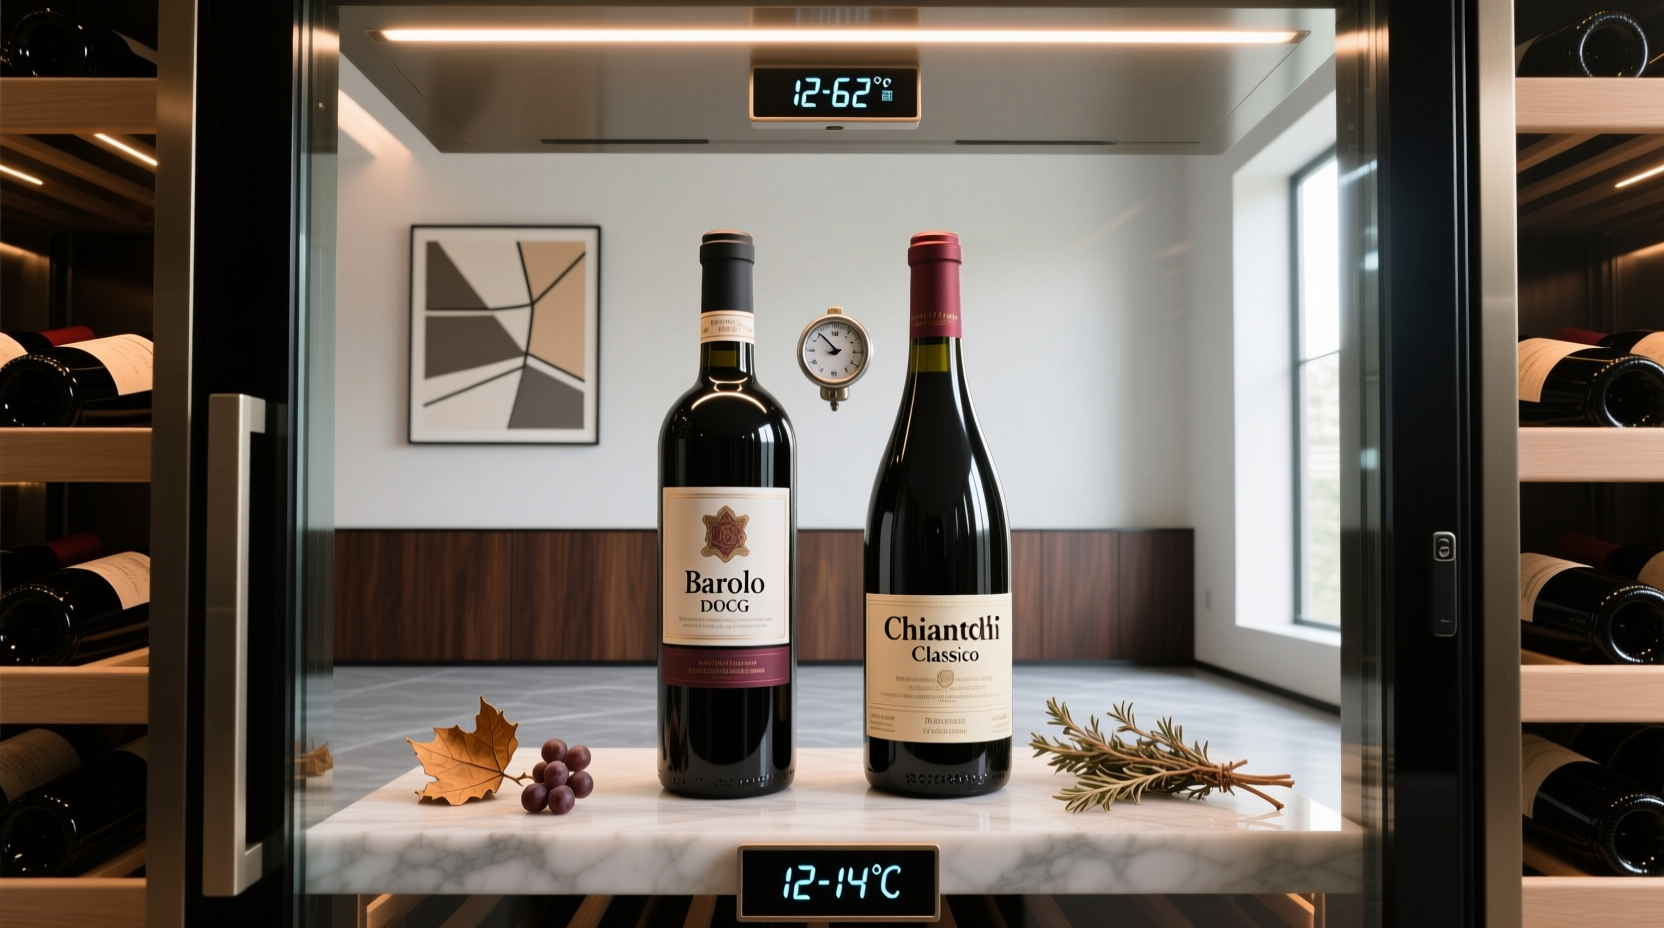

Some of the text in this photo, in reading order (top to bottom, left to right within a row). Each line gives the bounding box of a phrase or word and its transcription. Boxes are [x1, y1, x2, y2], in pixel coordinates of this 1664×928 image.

[684, 569, 765, 595] Barolo
[700, 599, 750, 613] DOCG
[911, 645, 979, 663] Classico
[782, 863, 902, 901] 12-14°C
